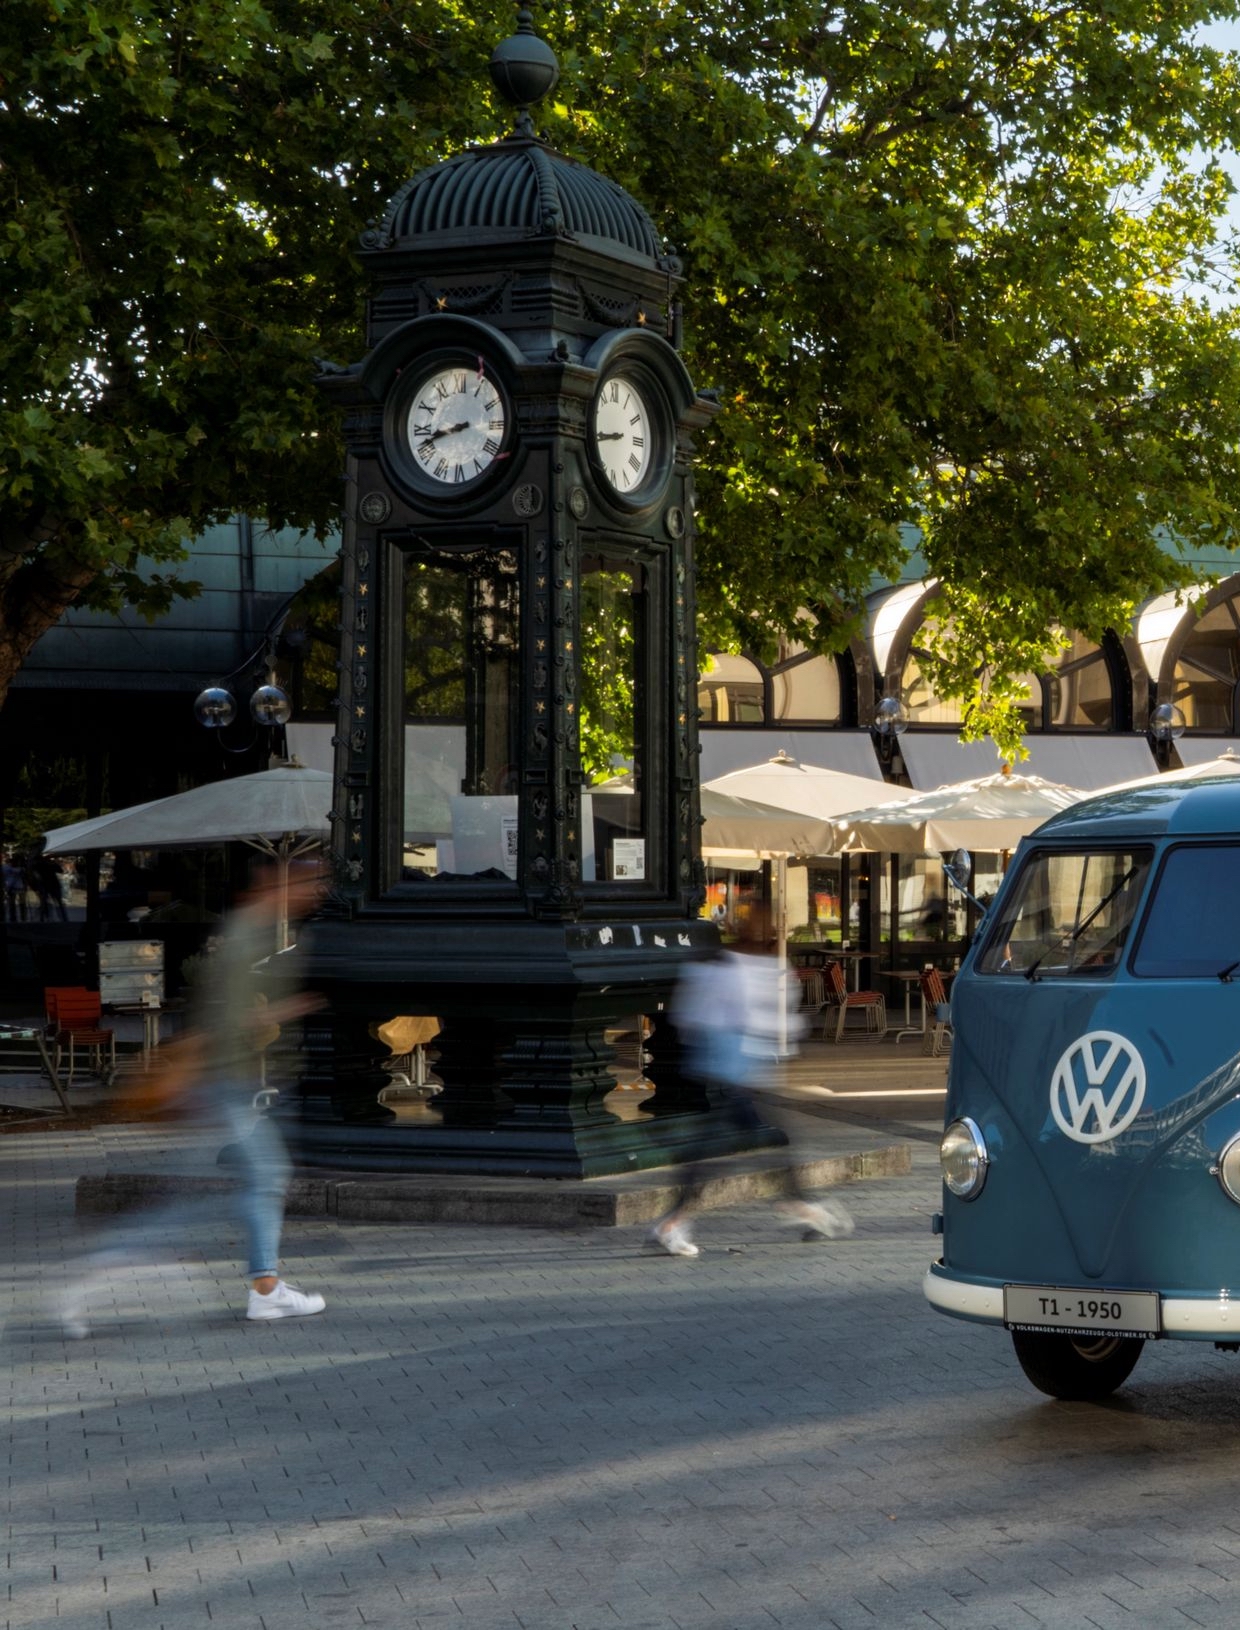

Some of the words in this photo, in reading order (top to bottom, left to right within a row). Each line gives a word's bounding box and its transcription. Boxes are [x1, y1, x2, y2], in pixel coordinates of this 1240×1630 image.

[1051, 1031, 1146, 1143] VW
[1038, 1297, 1060, 1316] T1
[1077, 1300, 1122, 1320] 1950
